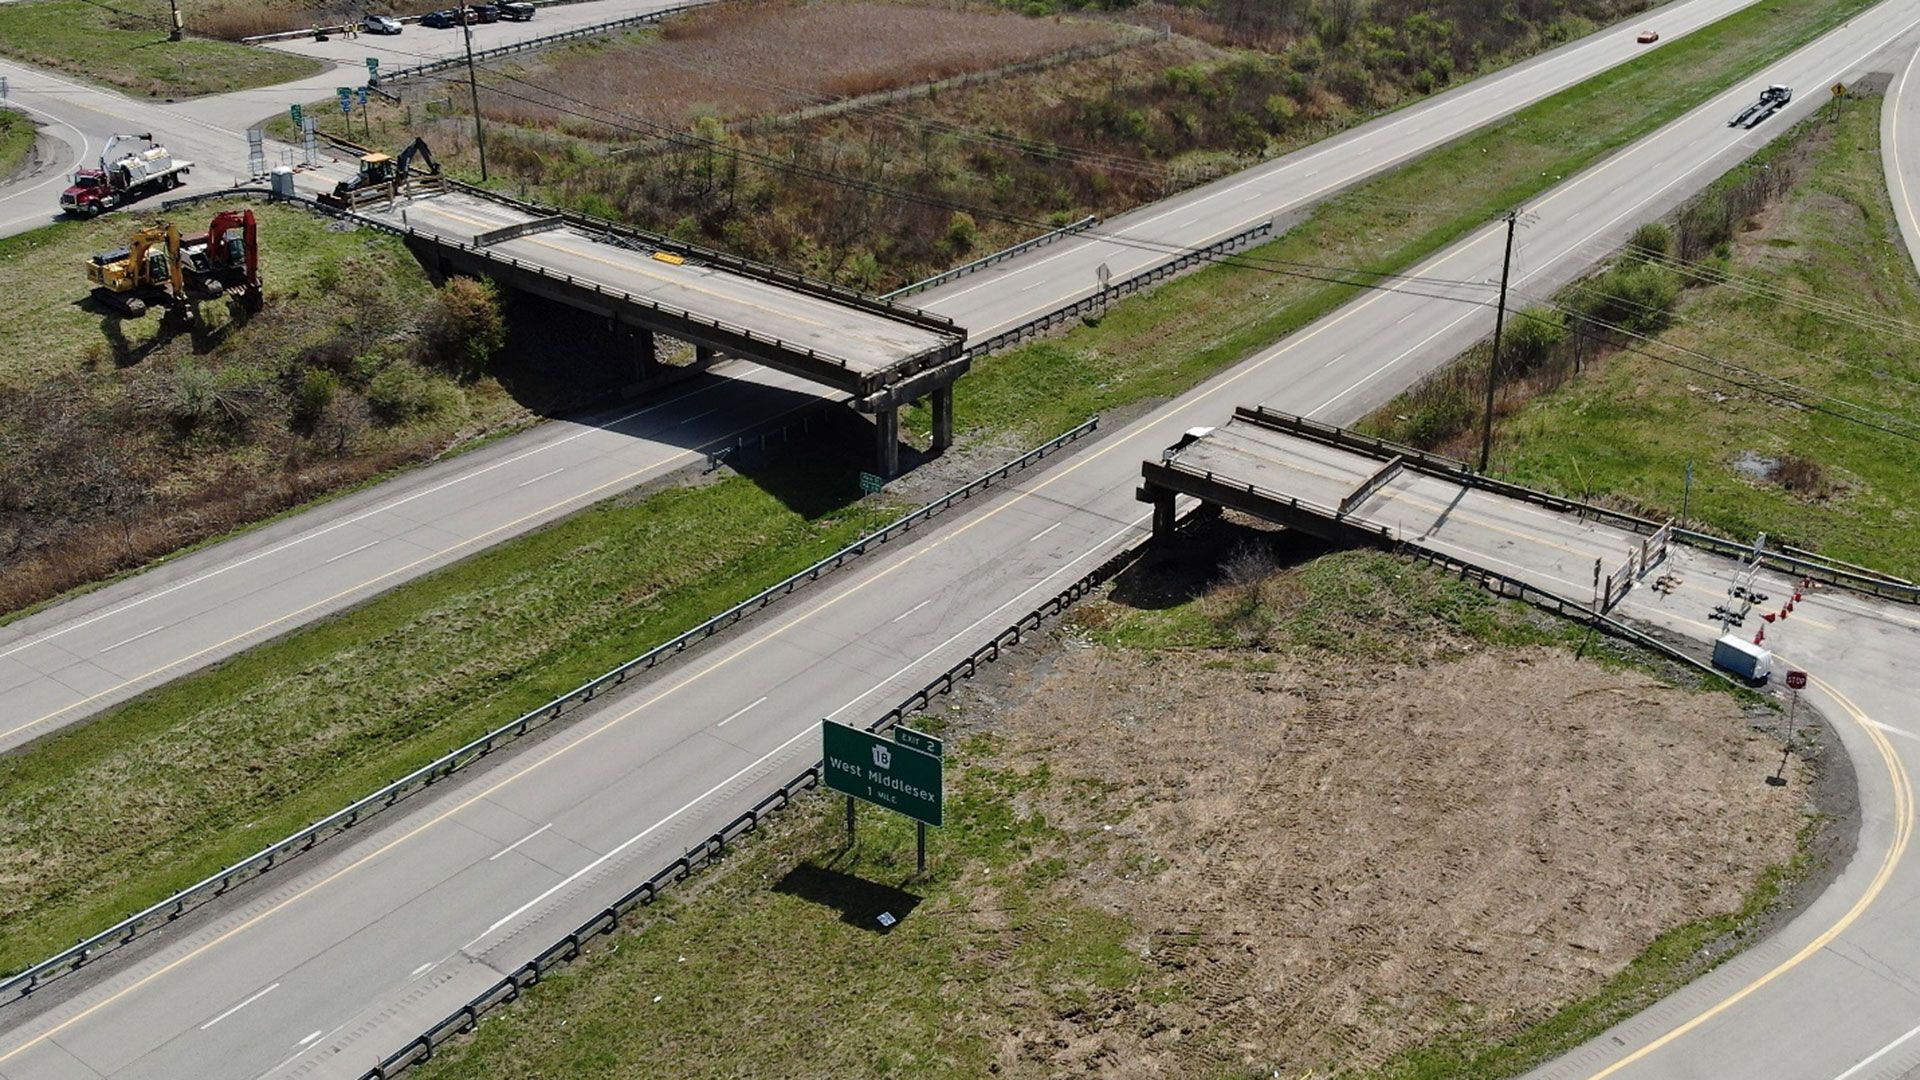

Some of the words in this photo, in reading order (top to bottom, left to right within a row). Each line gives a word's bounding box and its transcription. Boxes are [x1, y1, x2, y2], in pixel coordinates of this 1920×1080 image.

[1787, 676, 1805, 685] STOP
[902, 732, 920, 745] EXIT
[927, 740, 935, 752] 2
[876, 750, 889, 765] 18
[829, 756, 862, 778] West
[868, 770, 935, 803] Middlesex
[867, 786, 872, 796] 1
[877, 791, 897, 804] MILE
